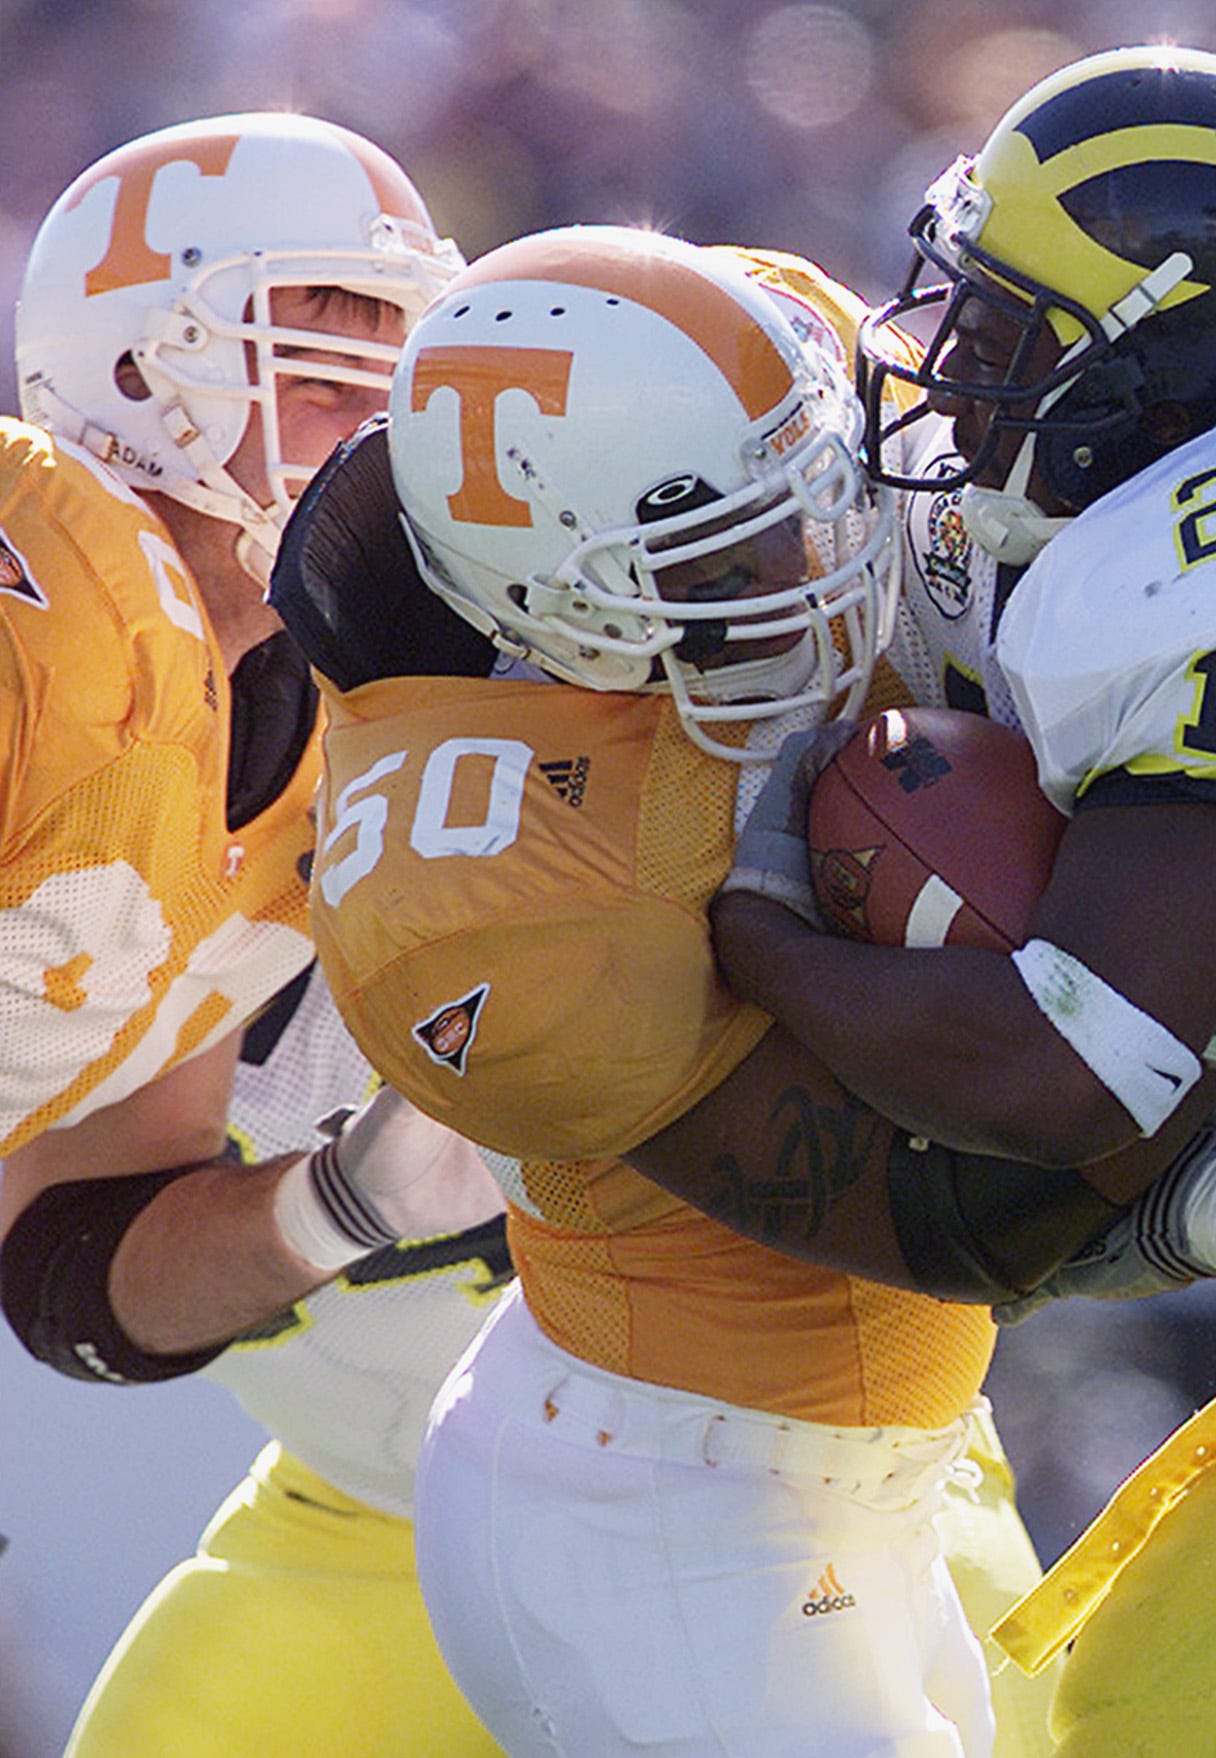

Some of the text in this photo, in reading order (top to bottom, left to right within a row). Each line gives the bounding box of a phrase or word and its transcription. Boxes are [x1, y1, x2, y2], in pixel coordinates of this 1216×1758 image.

[65, 134, 242, 299] T
[410, 344, 575, 529] T
[319, 736, 536, 911] 50
